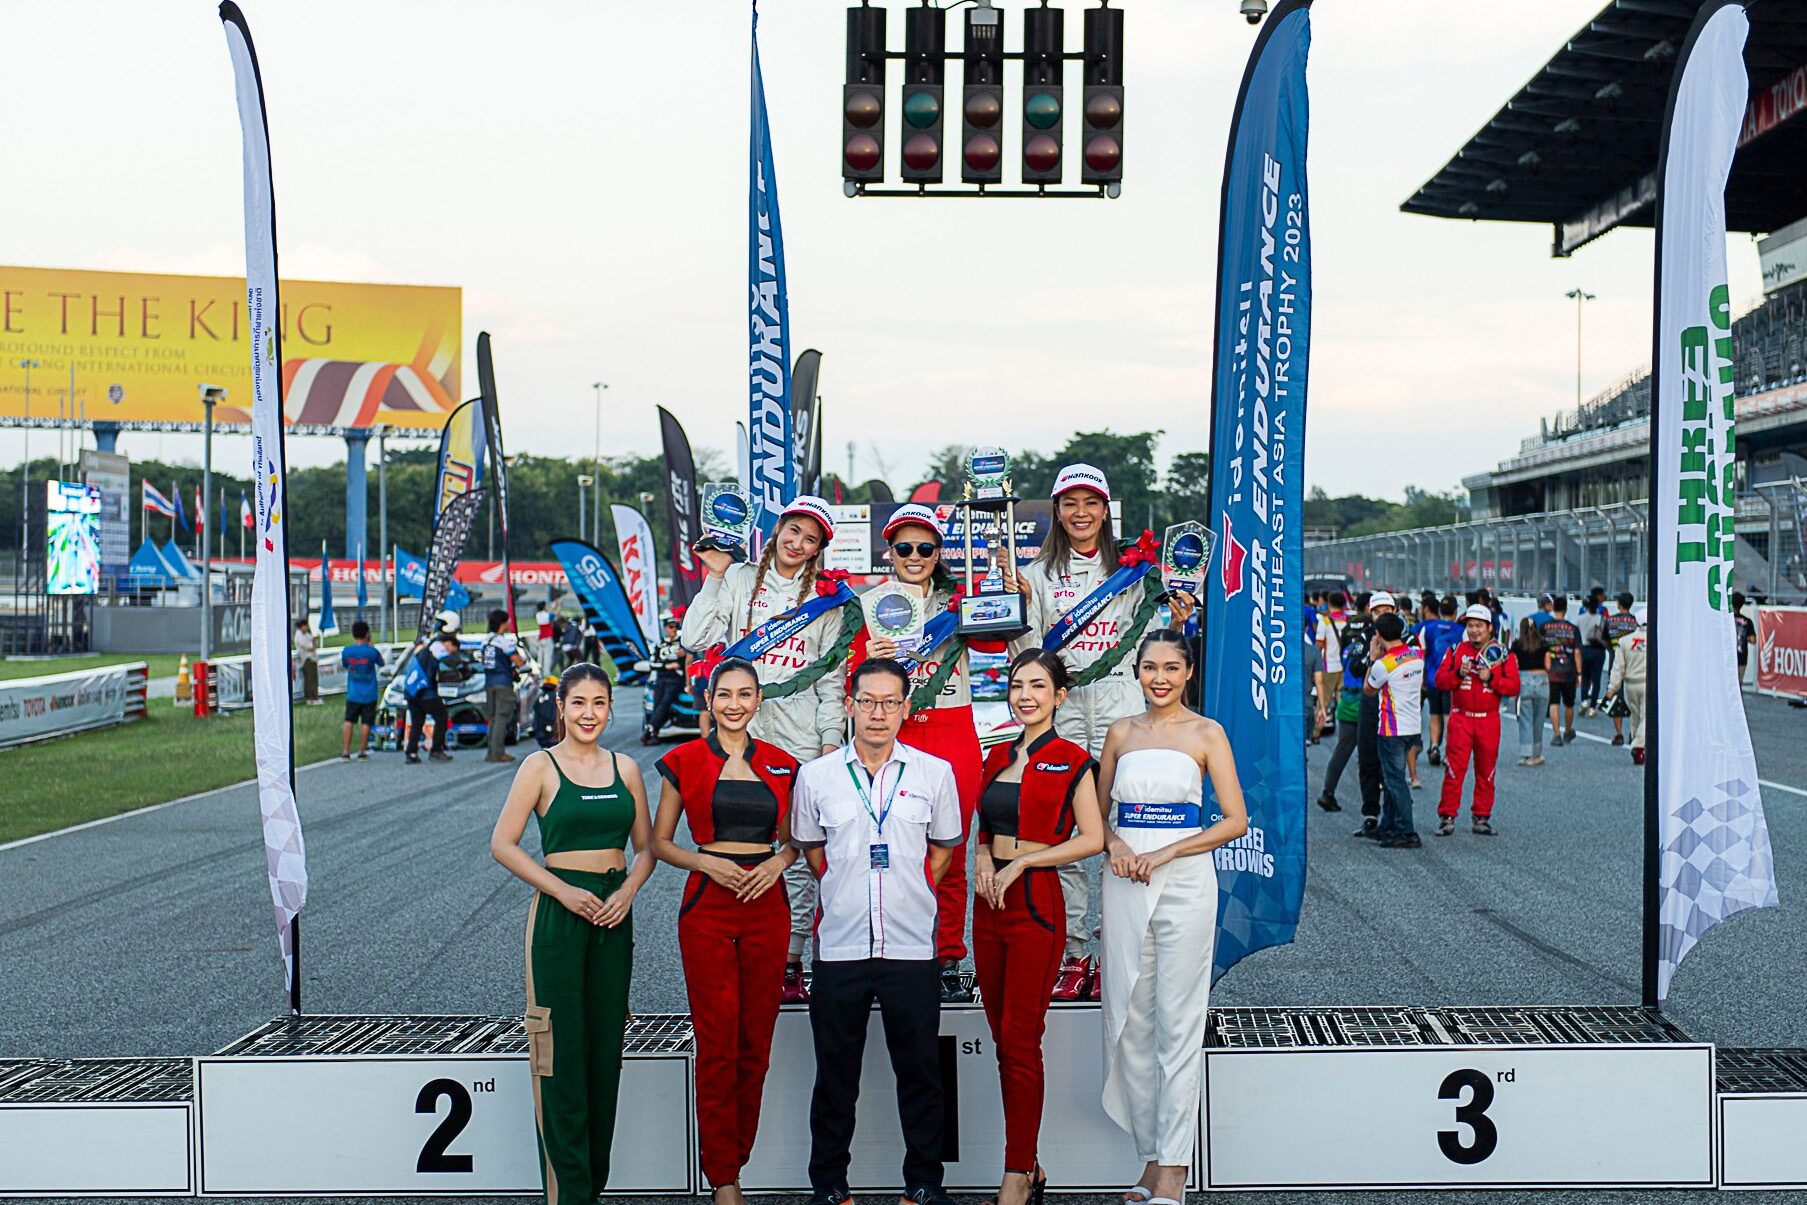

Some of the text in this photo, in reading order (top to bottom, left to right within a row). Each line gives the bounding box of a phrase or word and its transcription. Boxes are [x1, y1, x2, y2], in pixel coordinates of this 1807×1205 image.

[47, 291, 162, 340] THE
[189, 298, 333, 346] KIG
[79, 344, 138, 359] RESPECT
[144, 347, 187, 359] FROM
[1252, 152, 1281, 720] SUPER ENDURANCE
[1271, 191, 1302, 685] SOUTHEAST ASIA TROPHY 2023
[579, 553, 611, 589] GS
[1053, 589, 1075, 599] arto
[1073, 595, 1099, 618] idemitsu
[749, 612, 810, 653] SUPER ENDURANCE
[1061, 591, 1114, 641] SUPER ENDURANCE
[1124, 812, 1186, 821] SUPER ENDURANCE
[1144, 805, 1172, 813] idemitsu
